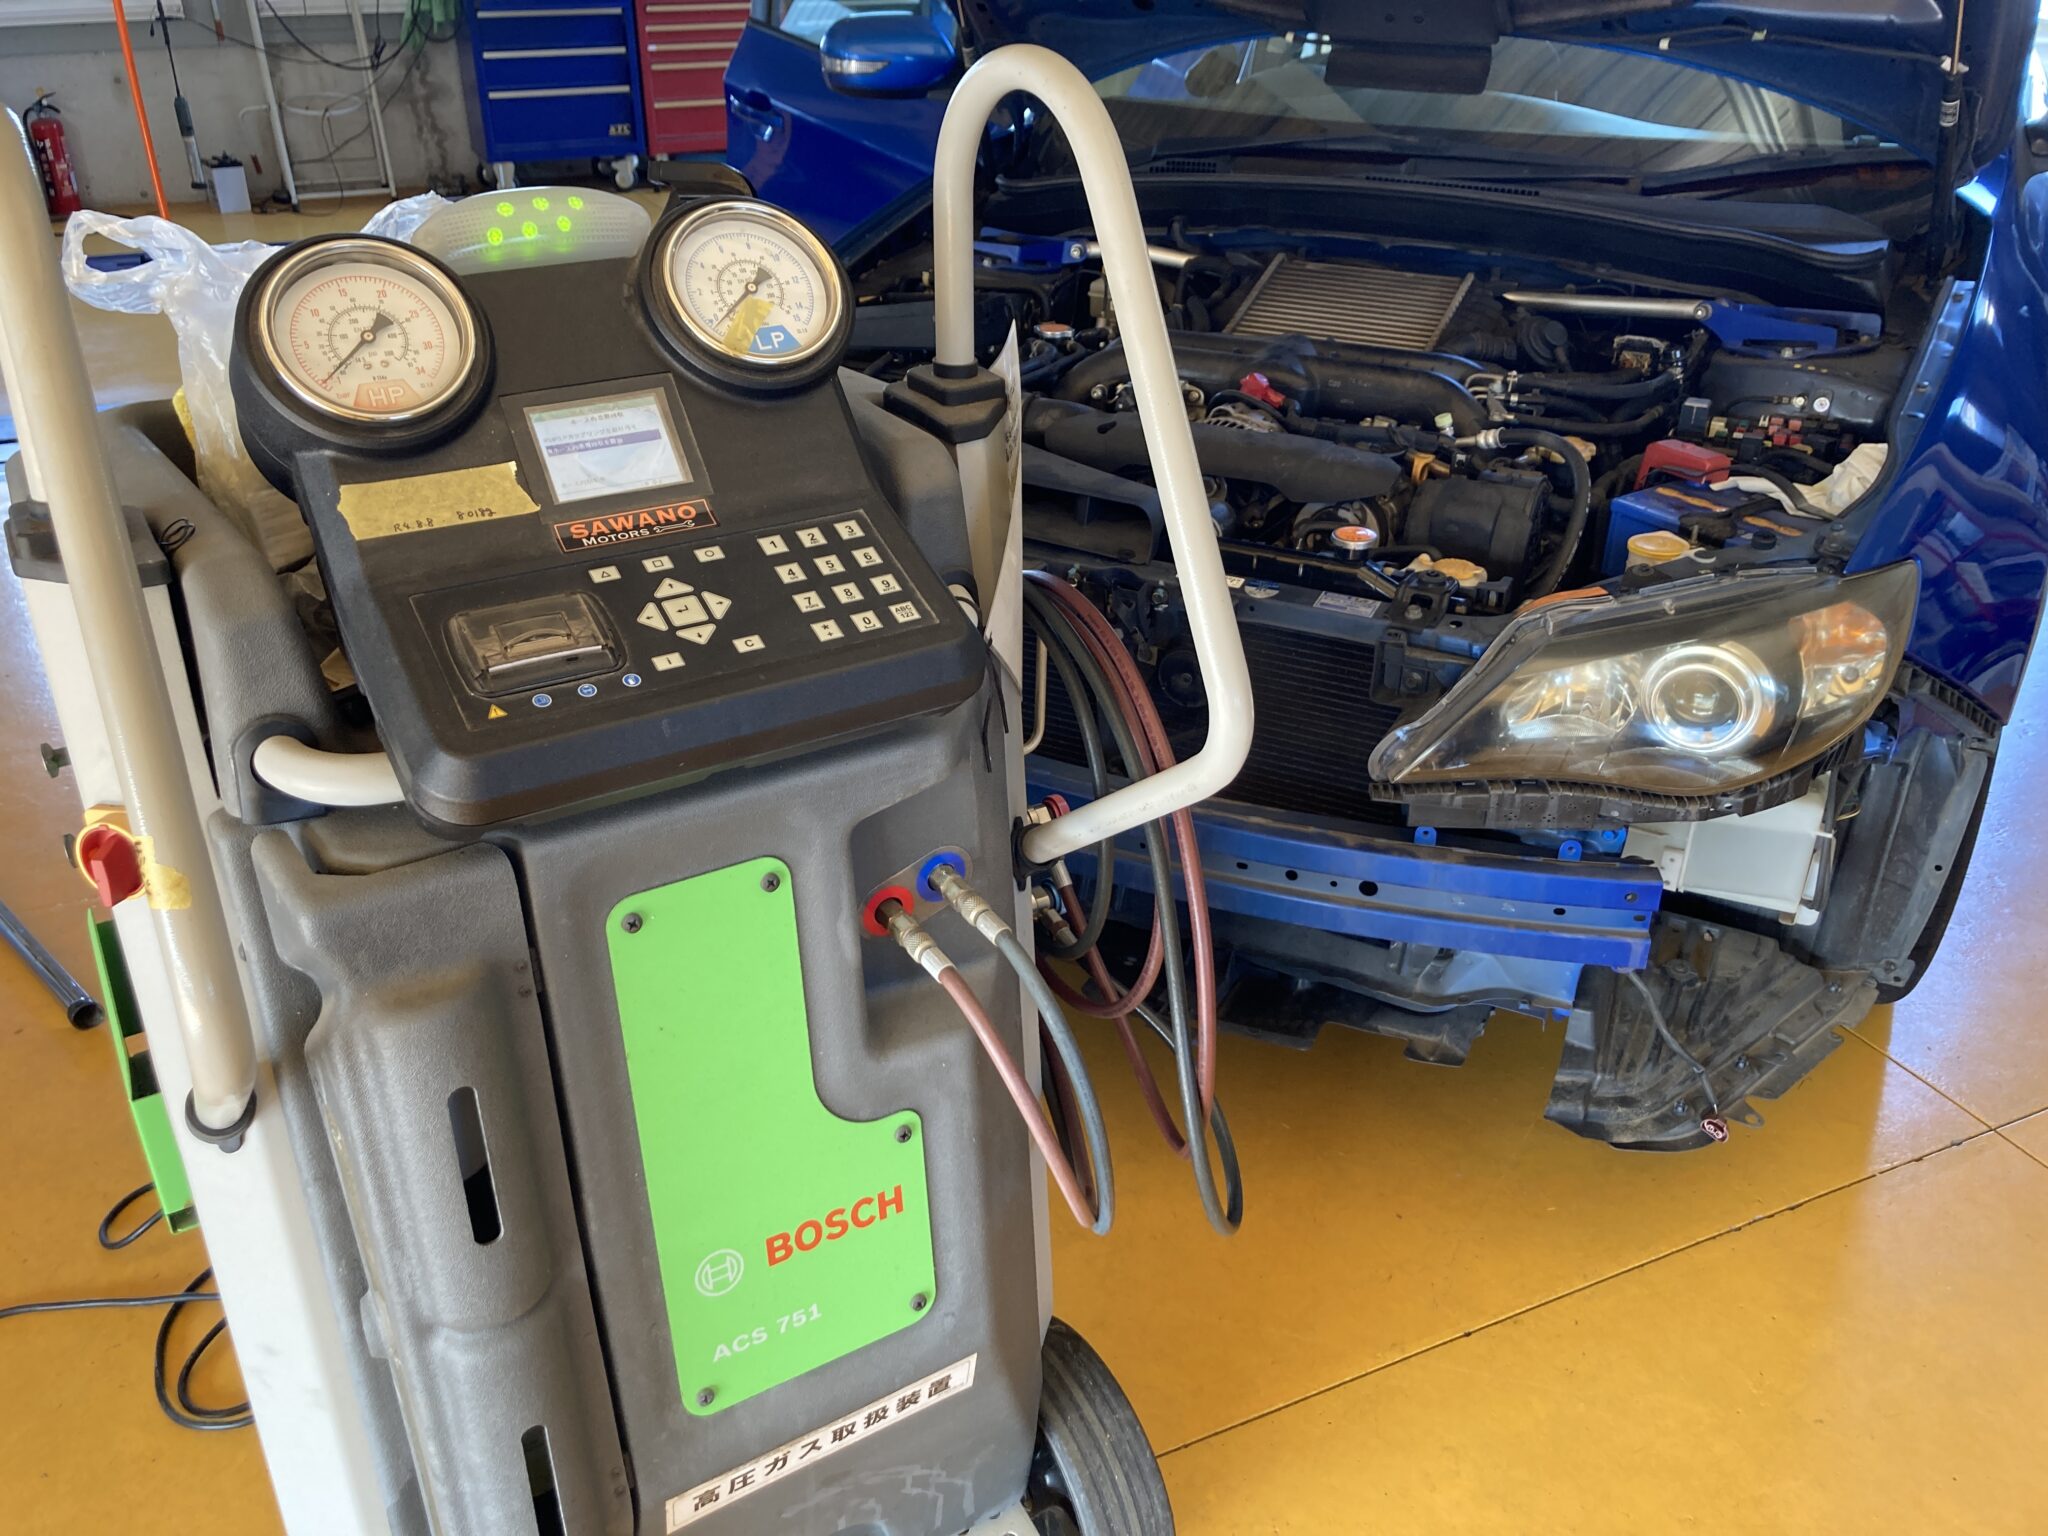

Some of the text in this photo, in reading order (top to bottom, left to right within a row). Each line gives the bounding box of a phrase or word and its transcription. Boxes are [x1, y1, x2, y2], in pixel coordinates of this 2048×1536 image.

[338, 288, 348, 297] 15
[376, 288, 387, 298] 20
[310, 308, 320, 317] 10
[408, 309, 419, 319] 25
[755, 331, 785, 350] LP
[422, 341, 433, 350] 30
[368, 386, 405, 407] HP
[569, 504, 697, 540] SAWANO
[844, 525, 854, 534] 3
[582, 528, 650, 547] MOTORS
[807, 533, 818, 541] 2
[769, 540, 778, 549] 1
[863, 552, 872, 561] 6
[825, 560, 834, 569] 5
[787, 568, 796, 576] 4
[881, 579, 890, 588] 9
[843, 588, 853, 597] 8
[803, 596, 811, 605] 7
[895, 604, 912, 613] ABC
[900, 611, 915, 619] 123
[862, 616, 872, 625] 0
[744, 639, 754, 647] C
[765, 1184, 904, 1267] BOSCH
[712, 1303, 822, 1363] ACS 751
[693, 1373, 953, 1512] 高圧ガス取扱装置
